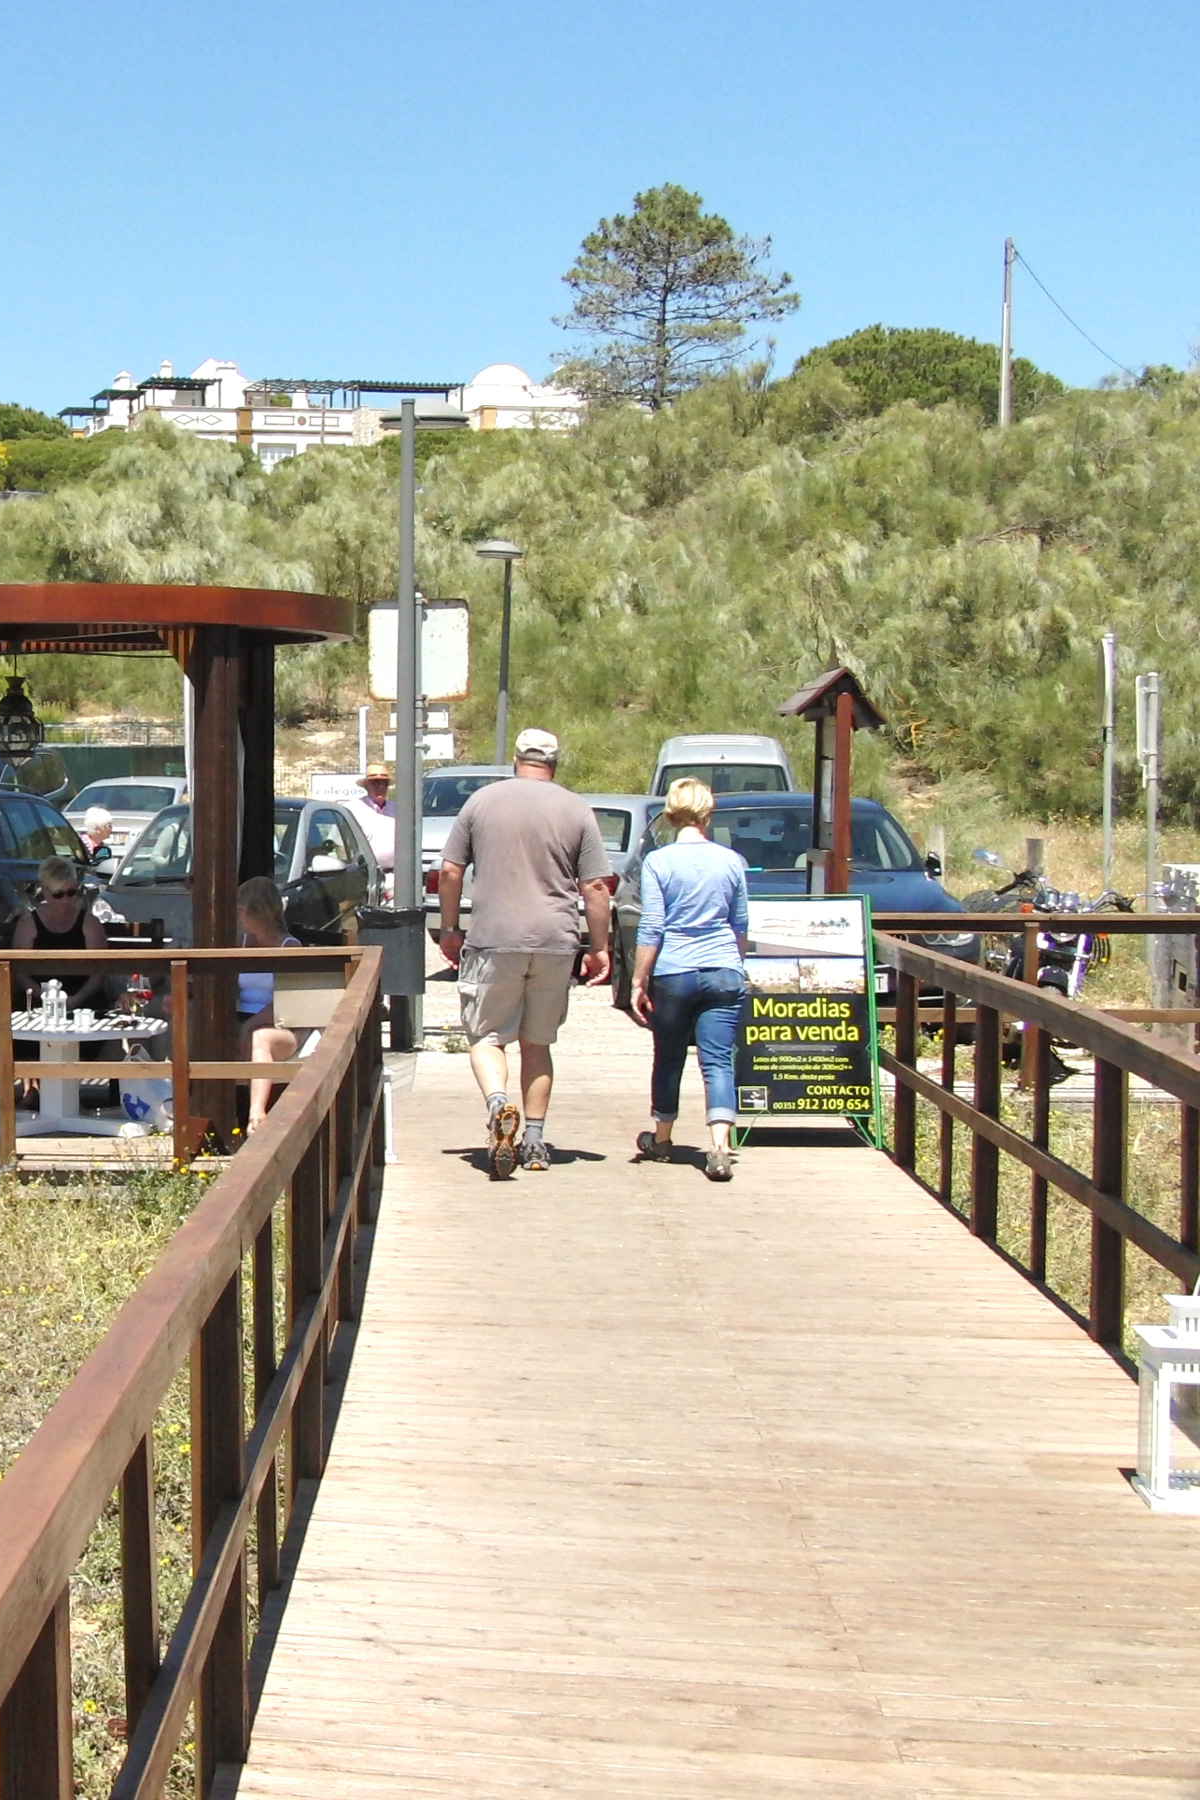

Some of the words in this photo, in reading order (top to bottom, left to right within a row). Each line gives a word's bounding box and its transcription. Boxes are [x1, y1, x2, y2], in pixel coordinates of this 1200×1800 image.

[753, 997, 851, 1018] Moradias
[746, 1025, 792, 1045] para
[795, 1020, 859, 1041] venda
[806, 1085, 870, 1096] CONTACTO
[797, 1098, 819, 1110] 912
[822, 1098, 844, 1110] 109
[846, 1098, 870, 1110] 654
